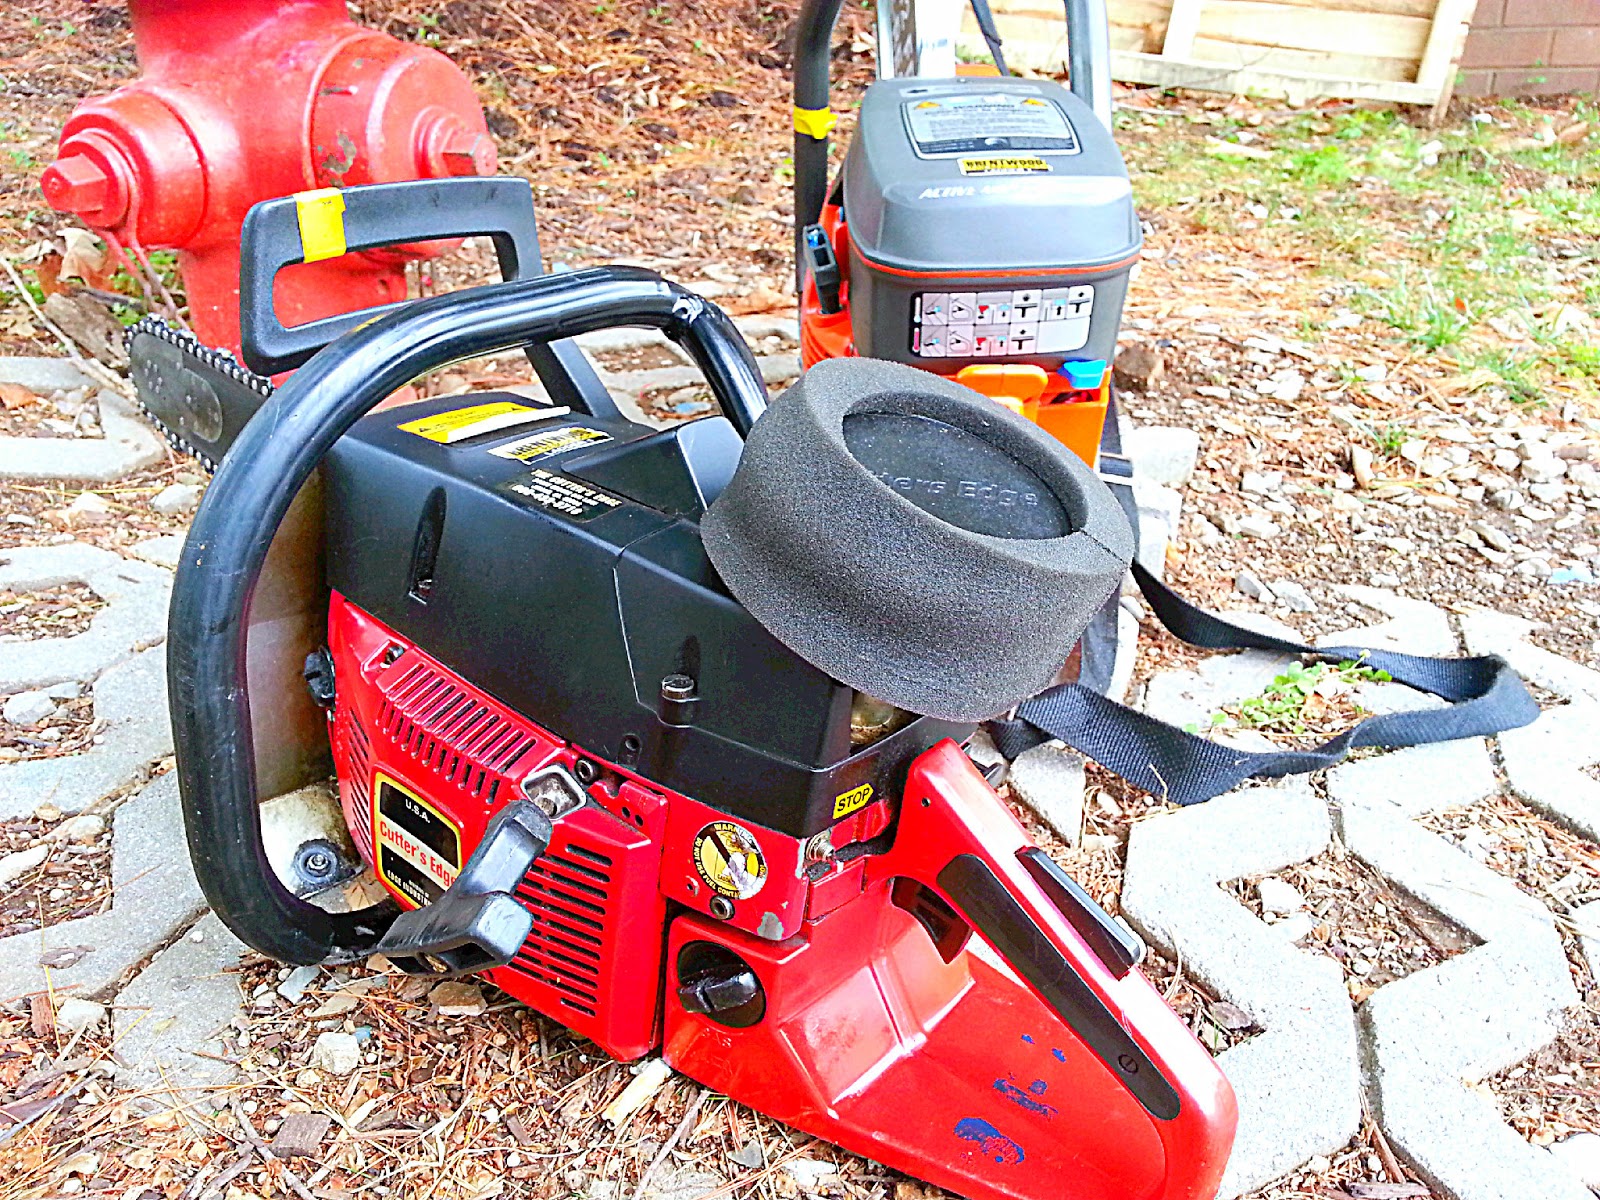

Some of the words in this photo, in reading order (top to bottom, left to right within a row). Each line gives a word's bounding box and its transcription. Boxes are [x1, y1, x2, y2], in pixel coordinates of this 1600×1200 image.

[957, 480, 1039, 506] Edge
[405, 798, 431, 824] U.S.A.
[837, 787, 871, 812] STOP
[379, 820, 428, 866] Cutter's
[693, 847, 701, 861] NOT
[695, 861, 706, 876] USE
[402, 881, 433, 907] INDUSTR
[702, 874, 717, 890] FUEL
